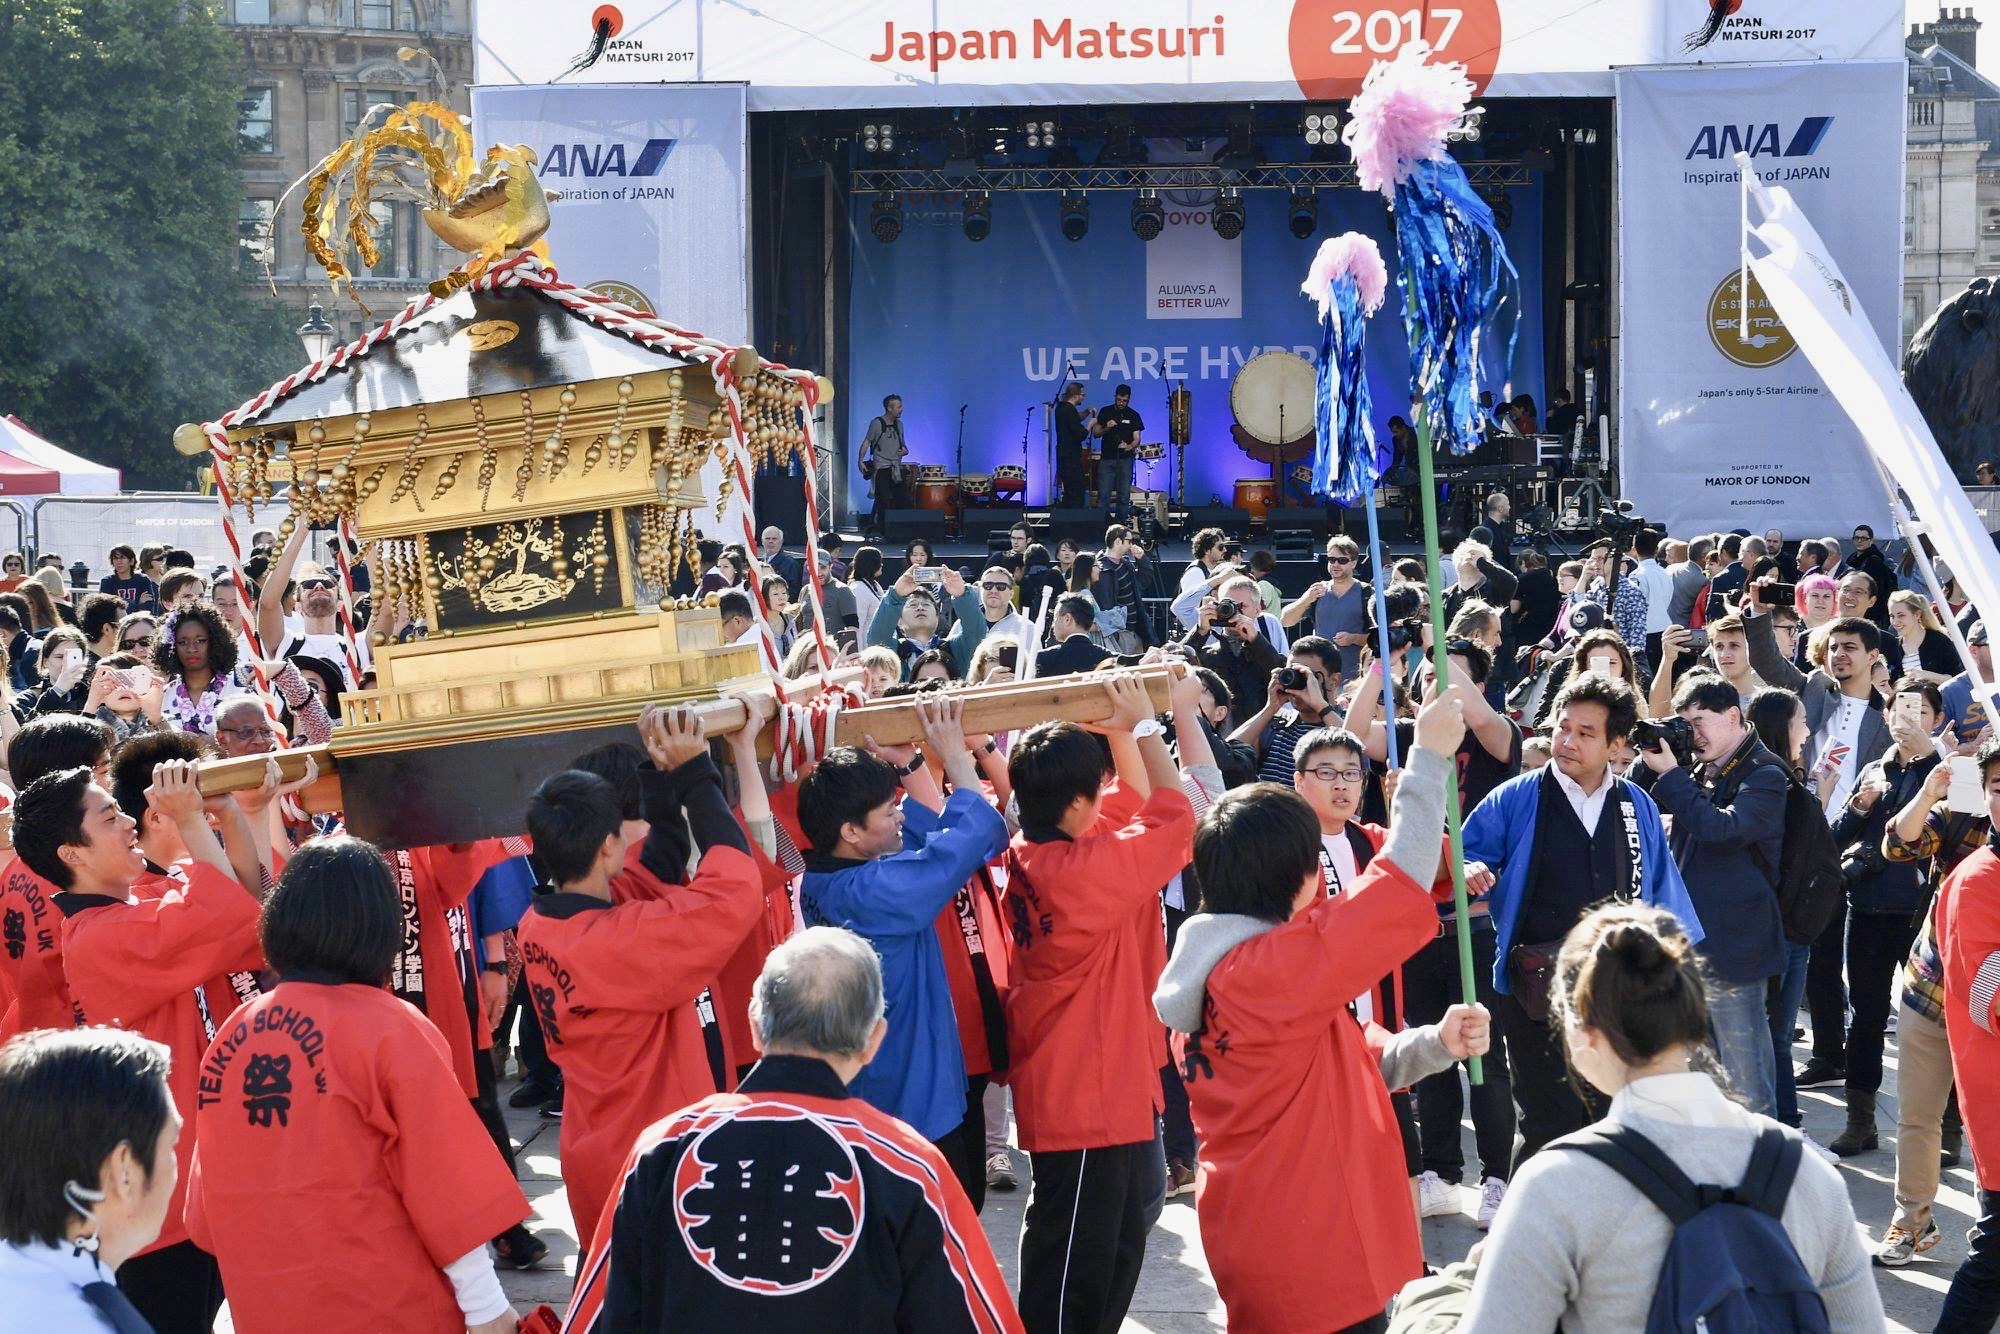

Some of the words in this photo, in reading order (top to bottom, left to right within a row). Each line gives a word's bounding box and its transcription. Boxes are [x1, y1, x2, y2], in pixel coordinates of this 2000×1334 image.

[1330, 8, 1464, 54] 2017
[1722, 30, 1783, 41] MATSURI
[1786, 29, 1816, 39] 2017
[870, 21, 1016, 72] Japan
[1032, 15, 1225, 59] Matsuri
[606, 53, 664, 63] MATSURI
[666, 52, 695, 62] 2017
[1685, 123, 1781, 160] ANA
[538, 144, 627, 177] ANA
[1684, 169, 1762, 187] Inspiratin
[1765, 168, 1782, 181] of
[1784, 167, 1830, 180] JAPAN
[612, 186, 627, 200] of
[630, 187, 675, 200] JAPAN
[1158, 284, 1206, 295] ALWAYS
[1208, 284, 1217, 295] A
[1158, 298, 1202, 308] BETTER
[1204, 298, 1230, 308] WAY
[1721, 300, 1728, 310] 5
[1730, 299, 1756, 310] STR
[1022, 346, 1091, 382] WE
[1100, 345, 1189, 380] ARE
[1698, 388, 1734, 398] Japan's
[1735, 389, 1754, 397] only
[1756, 386, 1785, 396] 5-Star
[1787, 385, 1819, 395] Airline
[1705, 477, 1742, 487] MAYOR
[1745, 476, 1760, 485] OF
[1762, 475, 1811, 485] LONDON
[1730, 498, 1785, 506] #LondonIsOpen
[135, 517, 166, 527] MAYOR
[179, 517, 215, 527] LONDON
[8, 873, 48, 926] SCHOOL
[37, 928, 54, 953] UK
[523, 941, 577, 1004] SCHOOL
[198, 1022, 249, 1111] TEIKYO
[253, 1005, 325, 1069] SCHOOL
